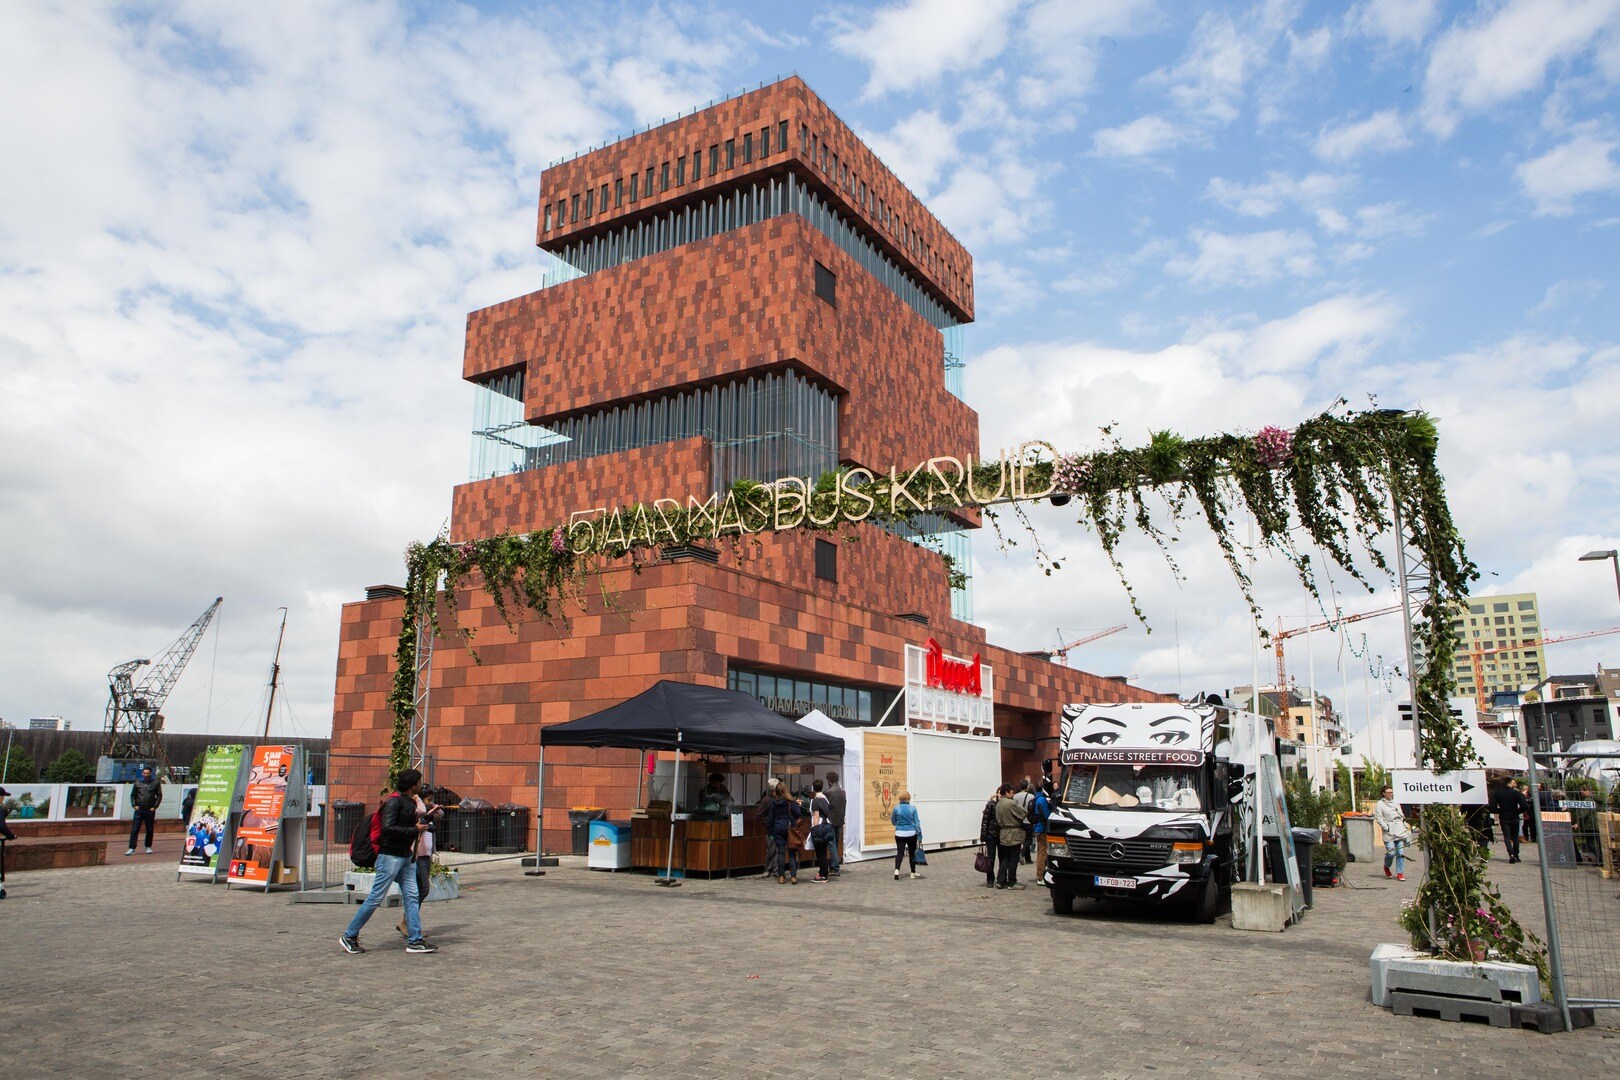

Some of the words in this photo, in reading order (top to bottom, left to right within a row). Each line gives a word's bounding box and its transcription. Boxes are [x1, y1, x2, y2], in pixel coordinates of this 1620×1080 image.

[687, 484, 769, 541] MAS
[924, 637, 982, 697] Duvel
[263, 751, 270, 763] 5
[1066, 751, 1124, 761] VIETNAMESE
[1127, 752, 1163, 761] STREET
[1166, 752, 1197, 762] FOOD
[1403, 782, 1452, 792] Toiletten
